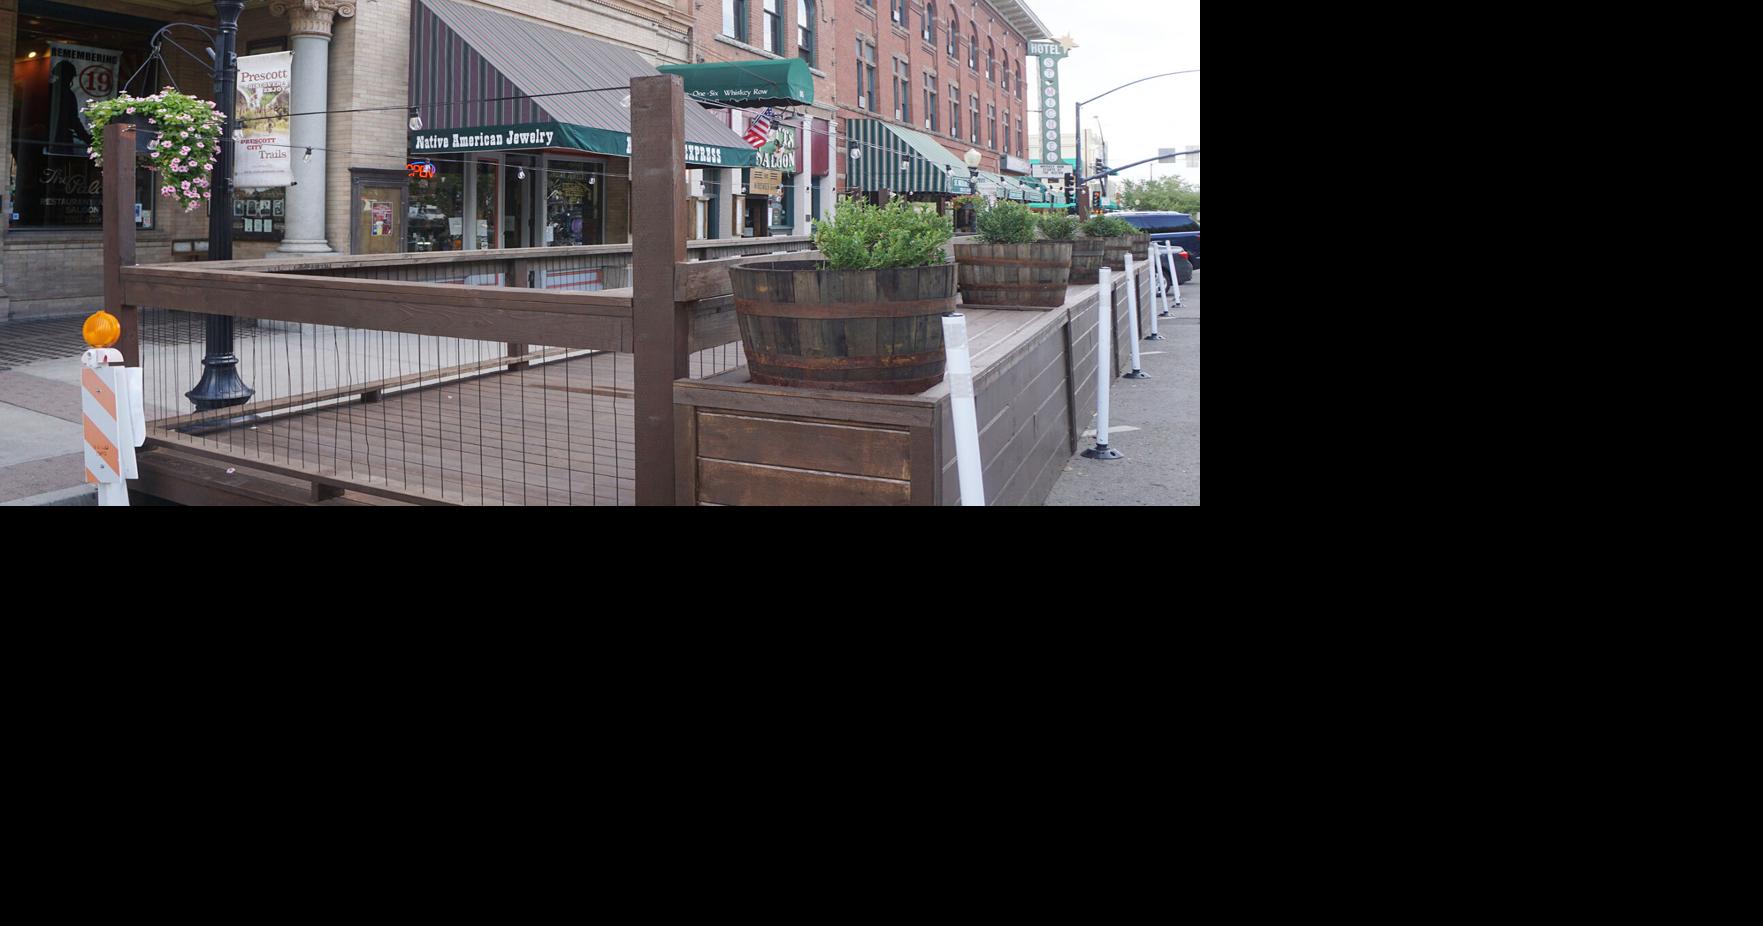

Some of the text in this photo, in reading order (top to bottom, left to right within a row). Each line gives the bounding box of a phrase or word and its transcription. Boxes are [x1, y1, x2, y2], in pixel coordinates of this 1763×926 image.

[1031, 43, 1060, 55] HOTEL
[51, 47, 118, 64] REMEMBERING
[85, 70, 112, 92] 19
[241, 70, 288, 82] Prescott
[723, 89, 751, 97] Whiskey
[415, 129, 554, 149] Native American Jewelry
[259, 150, 287, 160] Trails
